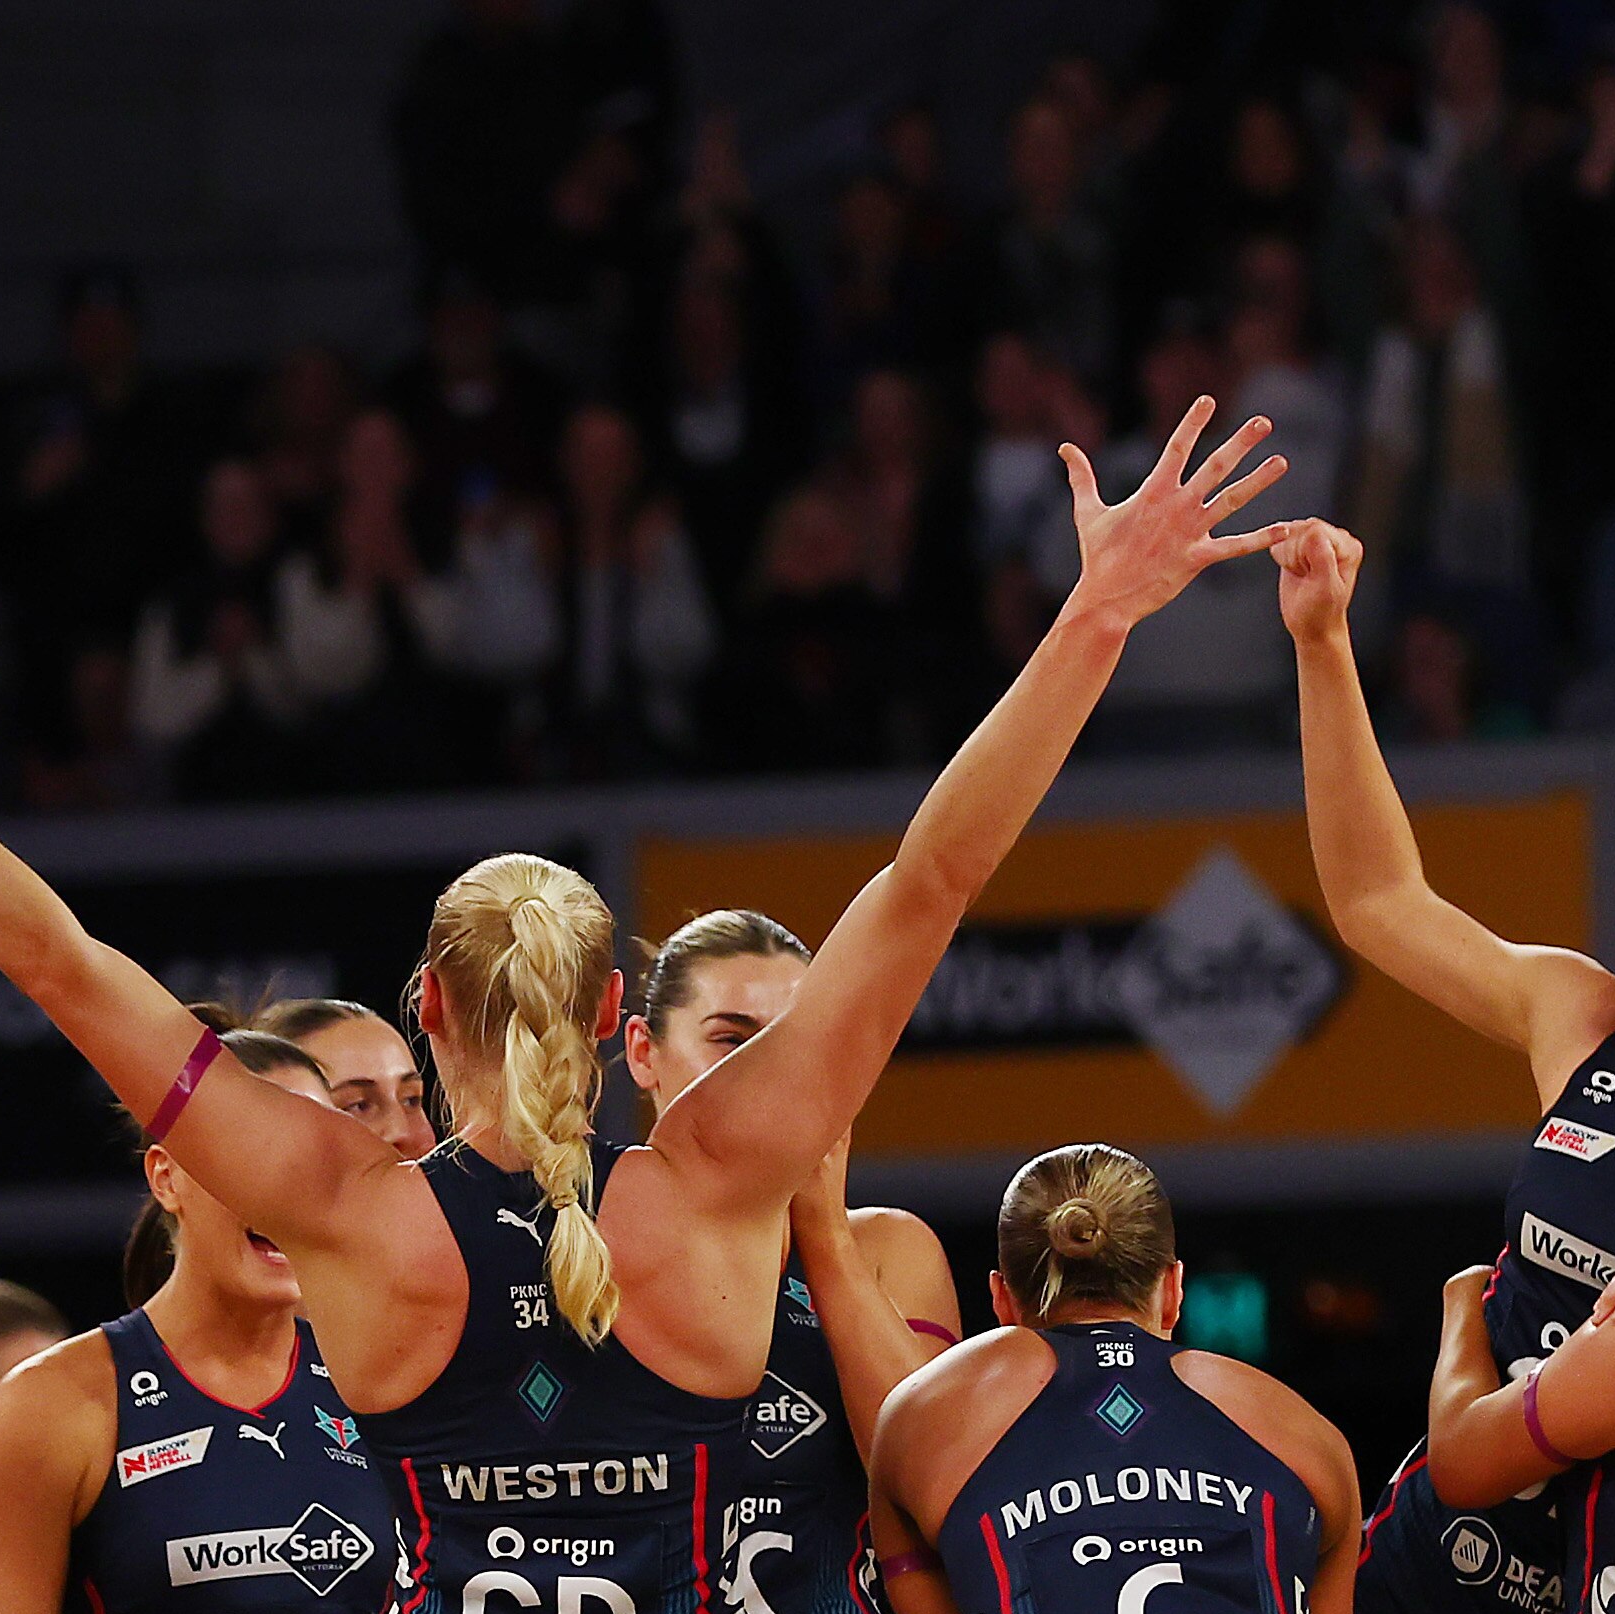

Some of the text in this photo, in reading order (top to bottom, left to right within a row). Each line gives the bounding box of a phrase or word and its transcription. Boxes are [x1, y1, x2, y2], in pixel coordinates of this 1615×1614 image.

[1583, 1086, 1612, 1105] origin
[510, 1284, 548, 1299] PKNC
[514, 1299, 550, 1330] 34
[1096, 1342, 1134, 1351] PKNC
[1098, 1350, 1135, 1367] 30
[135, 1391, 168, 1407] origin
[441, 1454, 669, 1502] WESTON
[1000, 1467, 1253, 1539] MOLONEY
[532, 1535, 615, 1567] origin
[1119, 1535, 1203, 1556] origin
